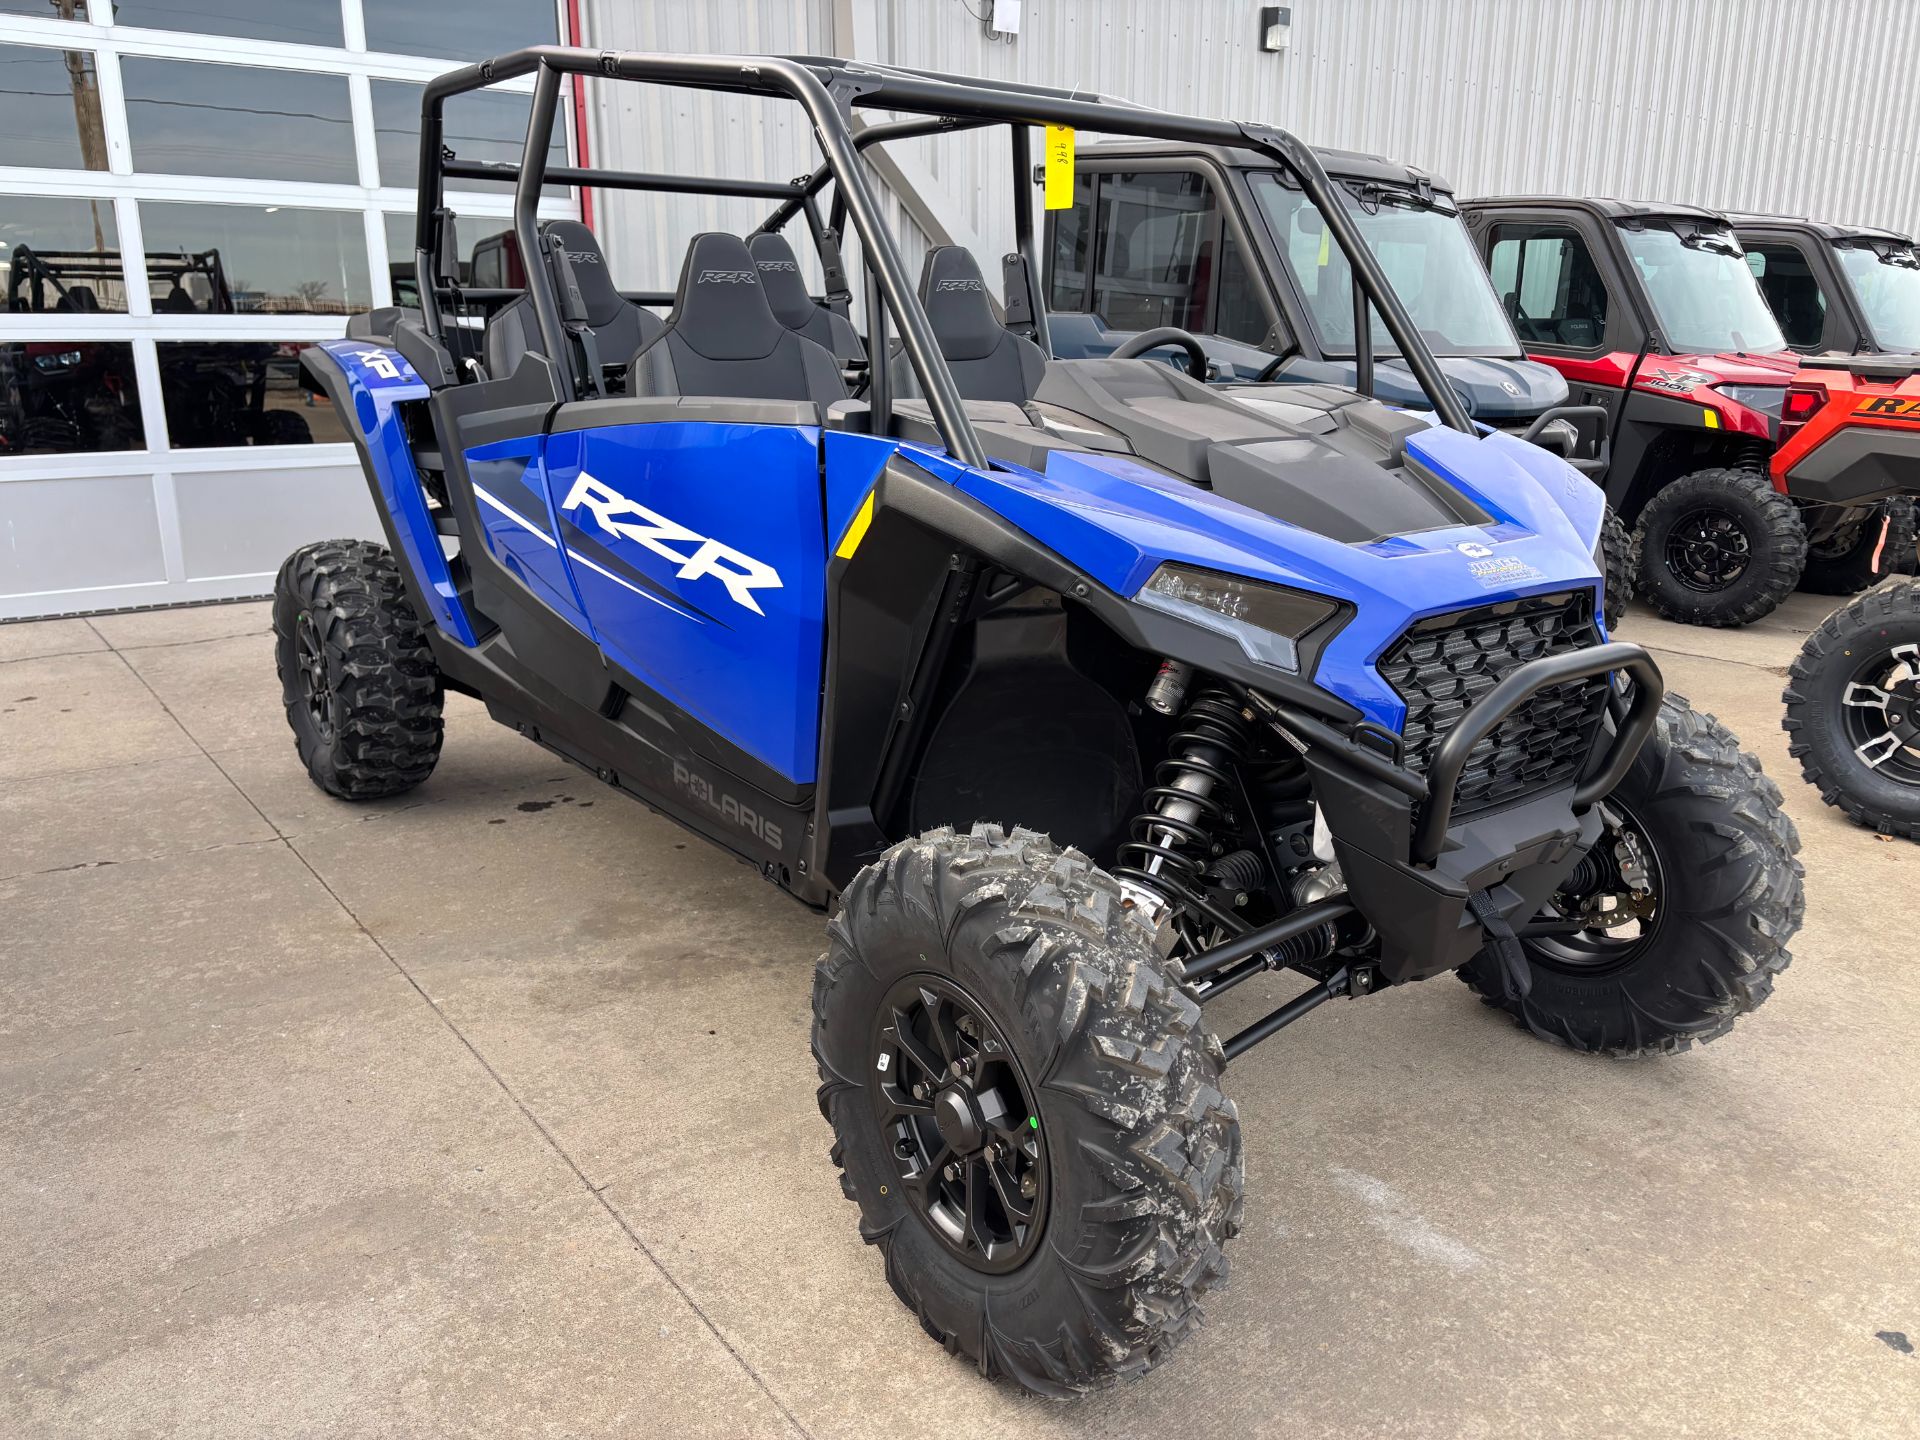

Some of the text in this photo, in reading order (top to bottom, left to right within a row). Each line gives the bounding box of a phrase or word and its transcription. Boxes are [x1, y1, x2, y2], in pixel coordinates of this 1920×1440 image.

[565, 251, 599, 263] ZR
[697, 270, 756, 284] RZR
[936, 279, 982, 291] RZR
[355, 349, 400, 378] XP
[1648, 368, 1708, 384] XP
[1650, 379, 1696, 393] 1000
[562, 471, 783, 617] RZR
[674, 760, 783, 851] POLARIS
